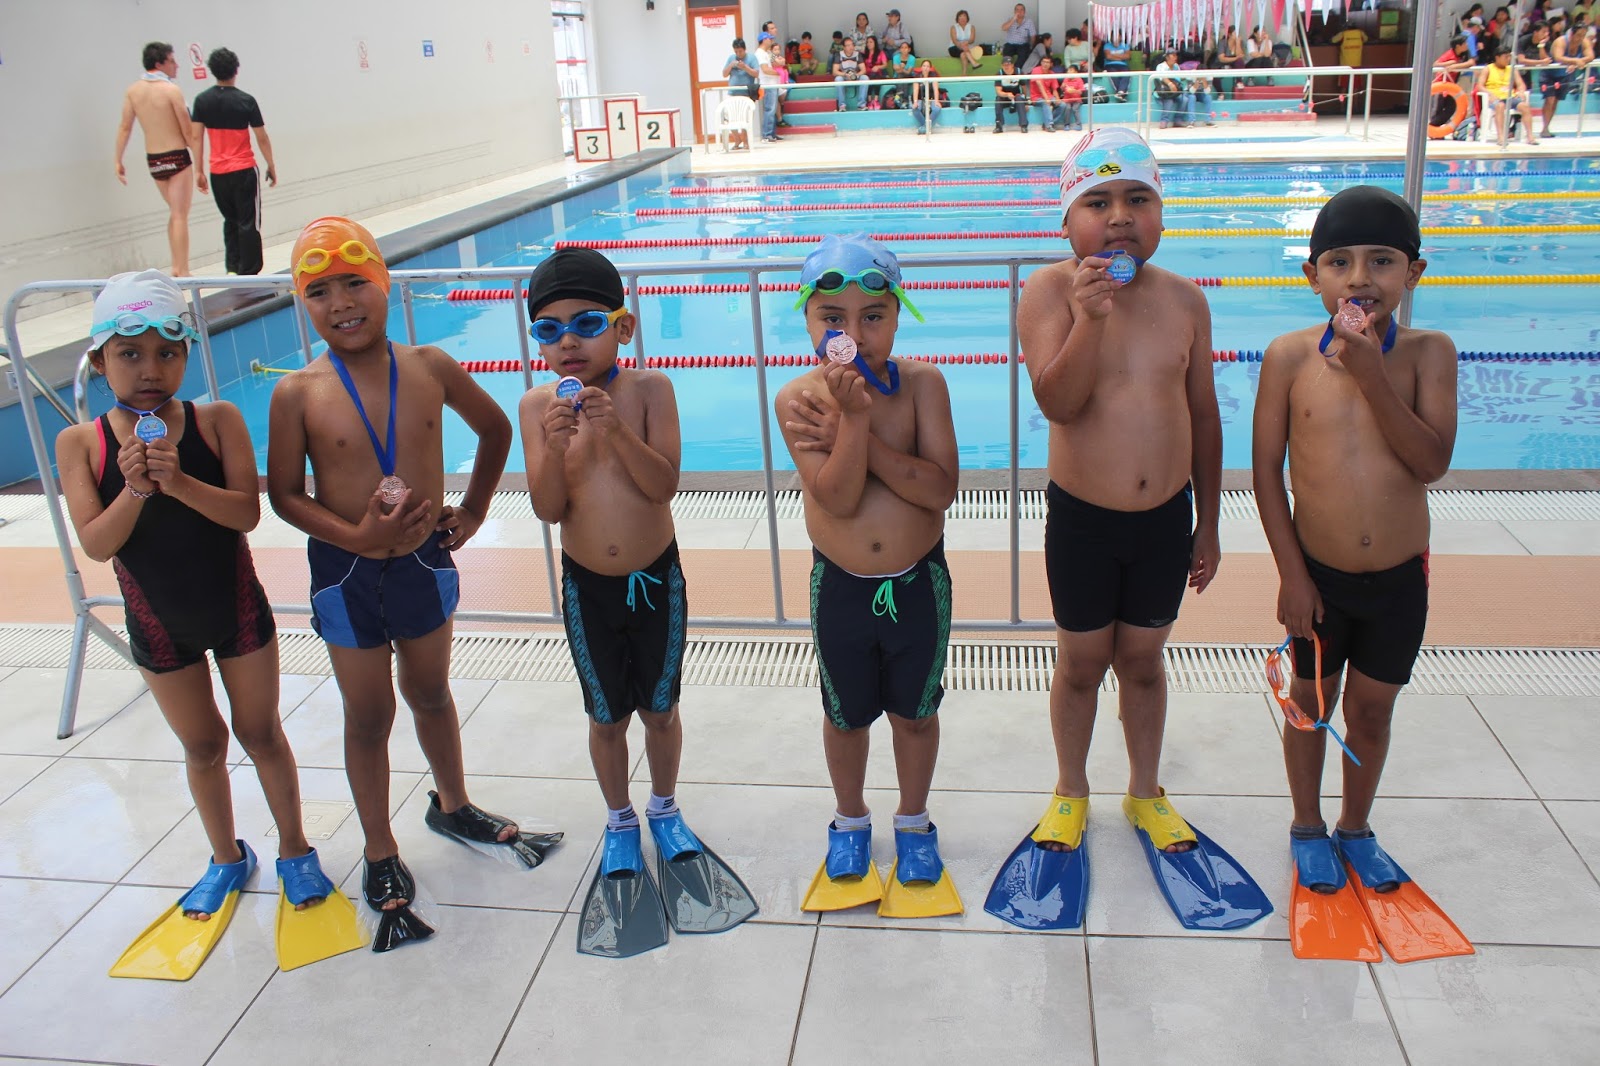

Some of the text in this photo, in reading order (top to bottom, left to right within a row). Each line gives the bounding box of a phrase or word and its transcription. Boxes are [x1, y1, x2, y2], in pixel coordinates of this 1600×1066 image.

[702, 17, 726, 25] ALMACEN
[617, 112, 626, 131] 1
[647, 121, 661, 140] 2
[587, 136, 599, 155] 3
[117, 300, 153, 311] speedo
